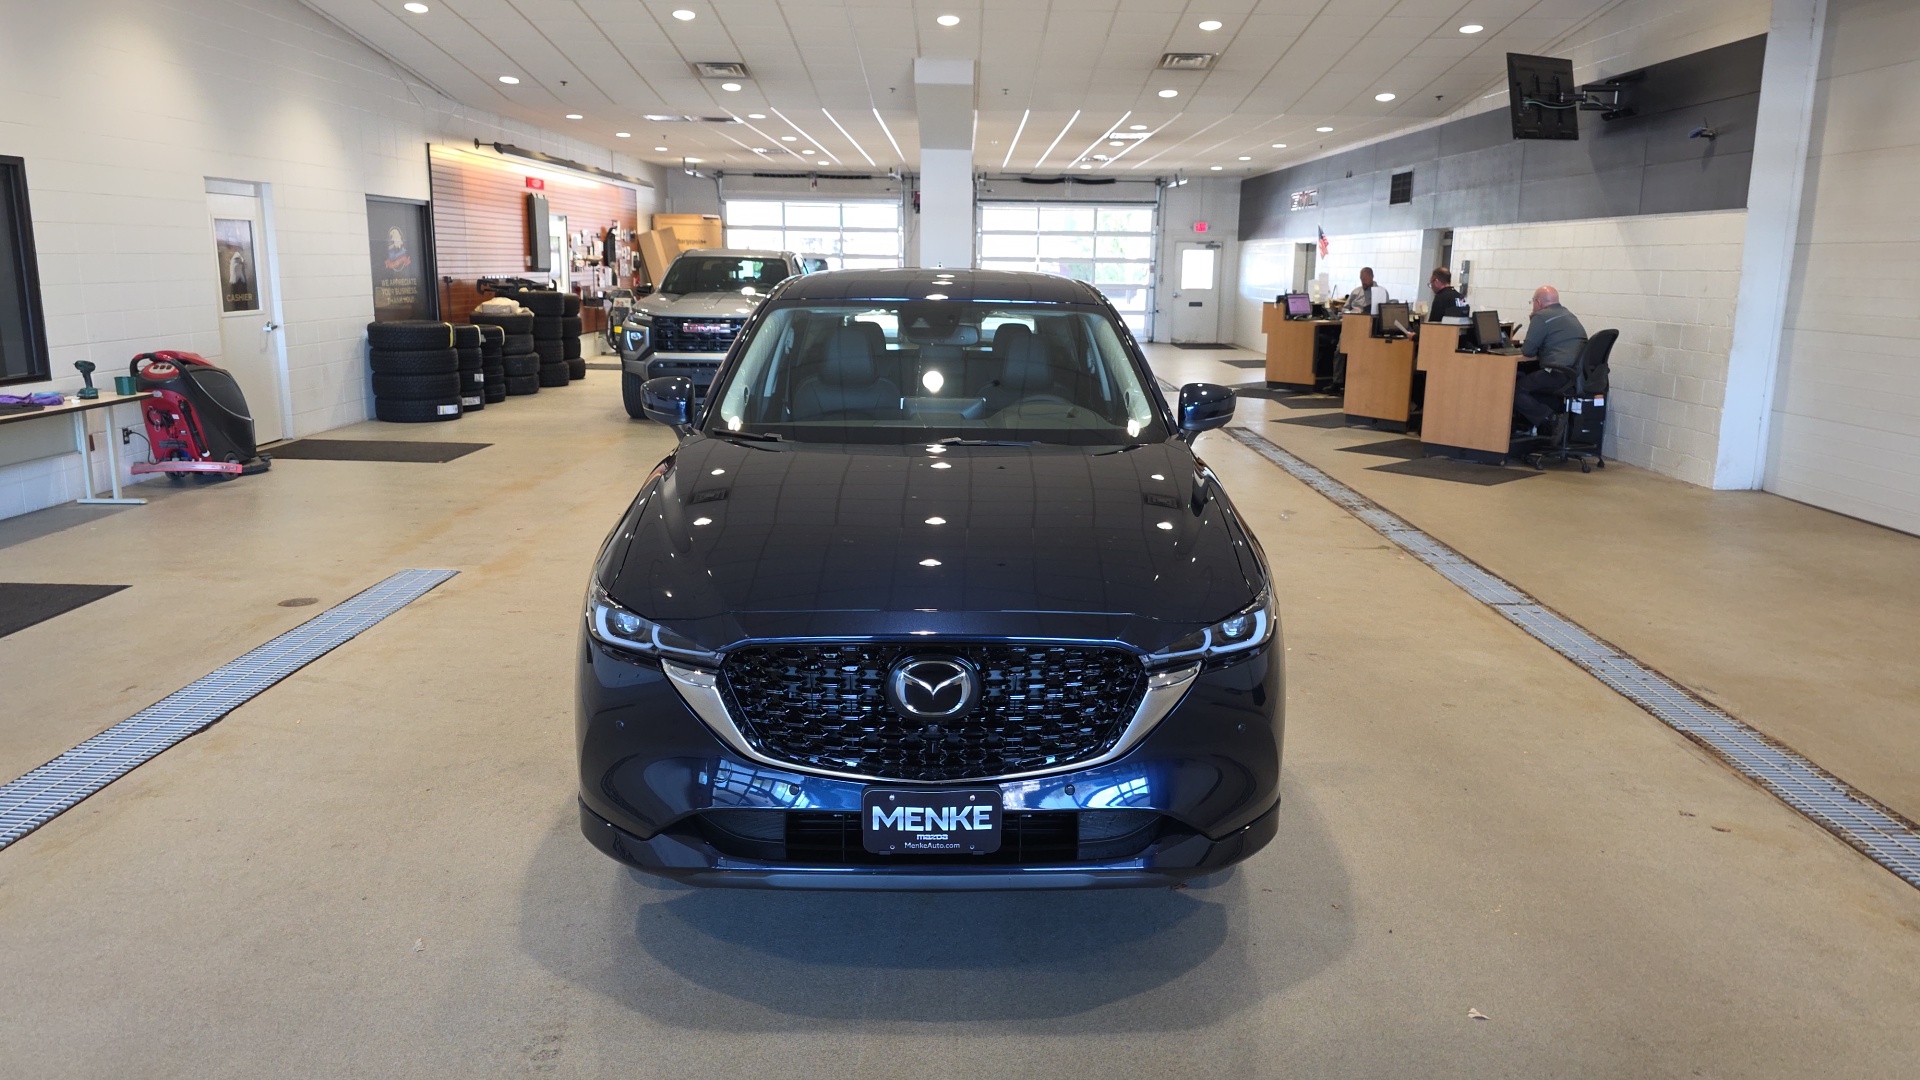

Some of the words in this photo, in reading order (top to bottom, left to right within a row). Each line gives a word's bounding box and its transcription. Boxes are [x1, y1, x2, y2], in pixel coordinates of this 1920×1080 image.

[226, 293, 253, 302] CASHIER
[683, 322, 730, 333] GMC
[872, 805, 993, 831] MENKE
